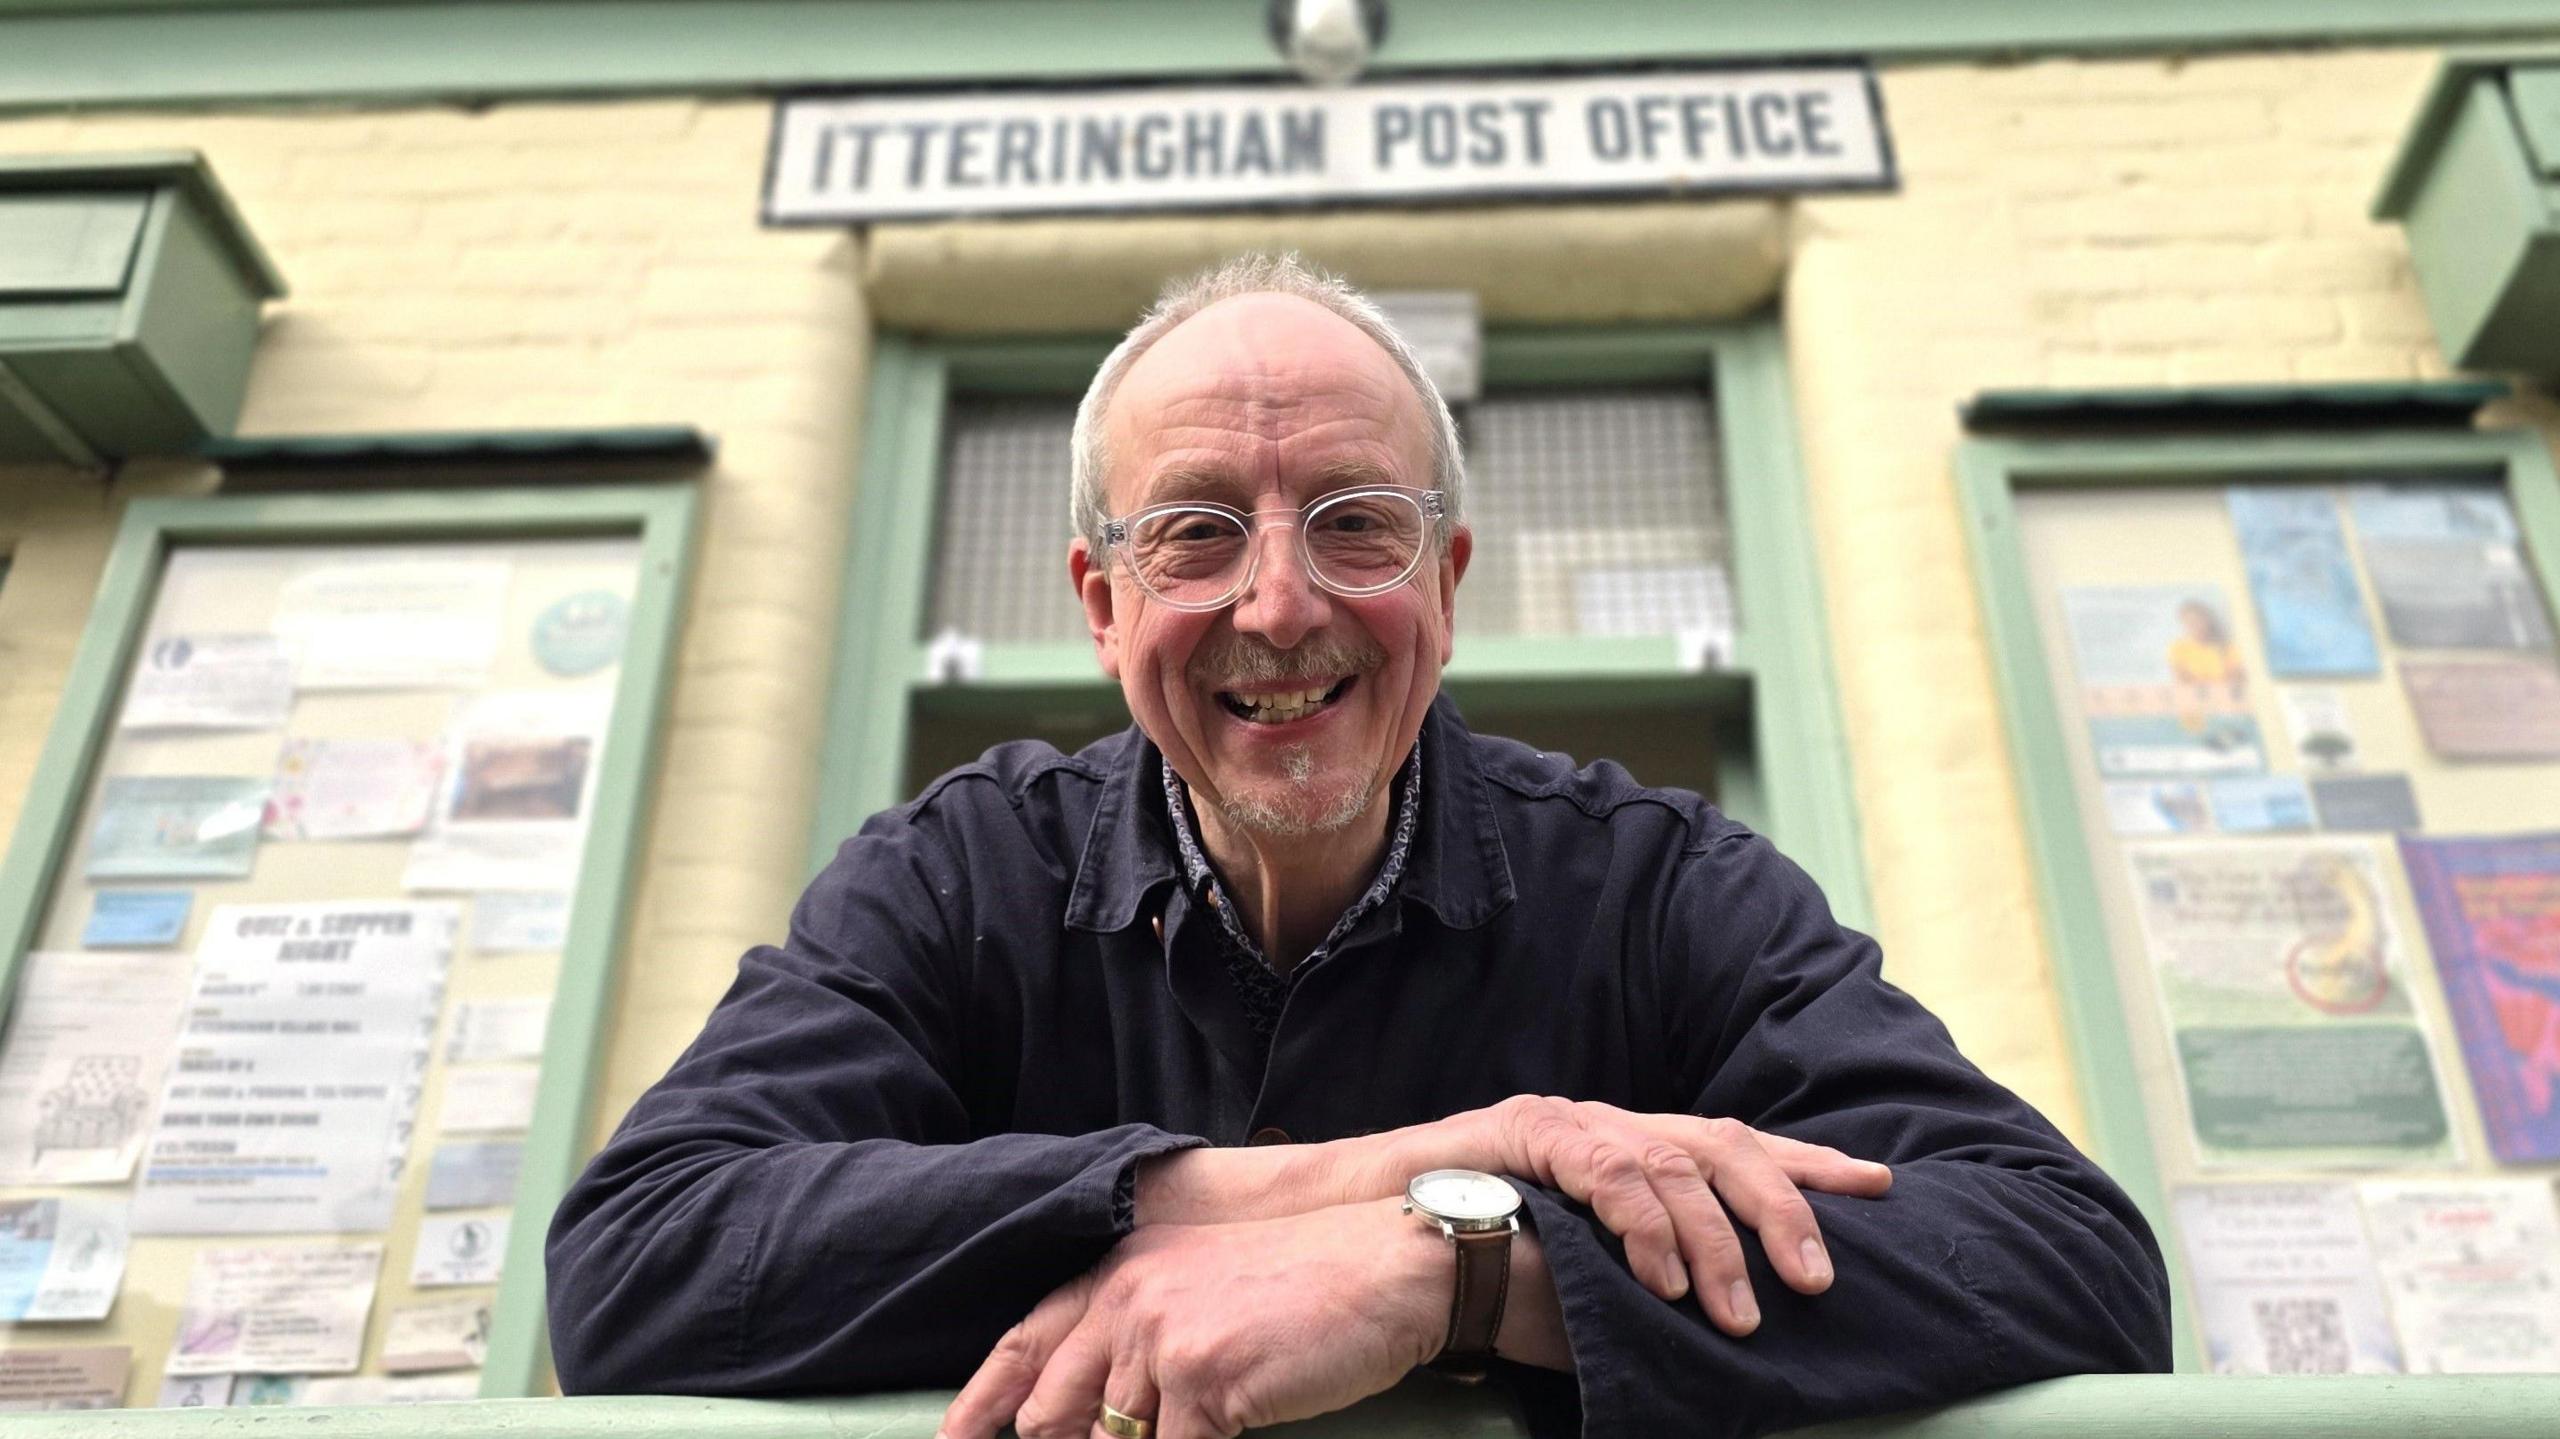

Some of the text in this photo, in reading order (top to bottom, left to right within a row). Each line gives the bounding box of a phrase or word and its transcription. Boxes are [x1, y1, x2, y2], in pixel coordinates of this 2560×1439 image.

[813, 92, 1841, 193] ITTERINGHAM POST OFFICE
[236, 911, 414, 938] QUIZ & SUPPER
[276, 938, 355, 963] NIGHT
